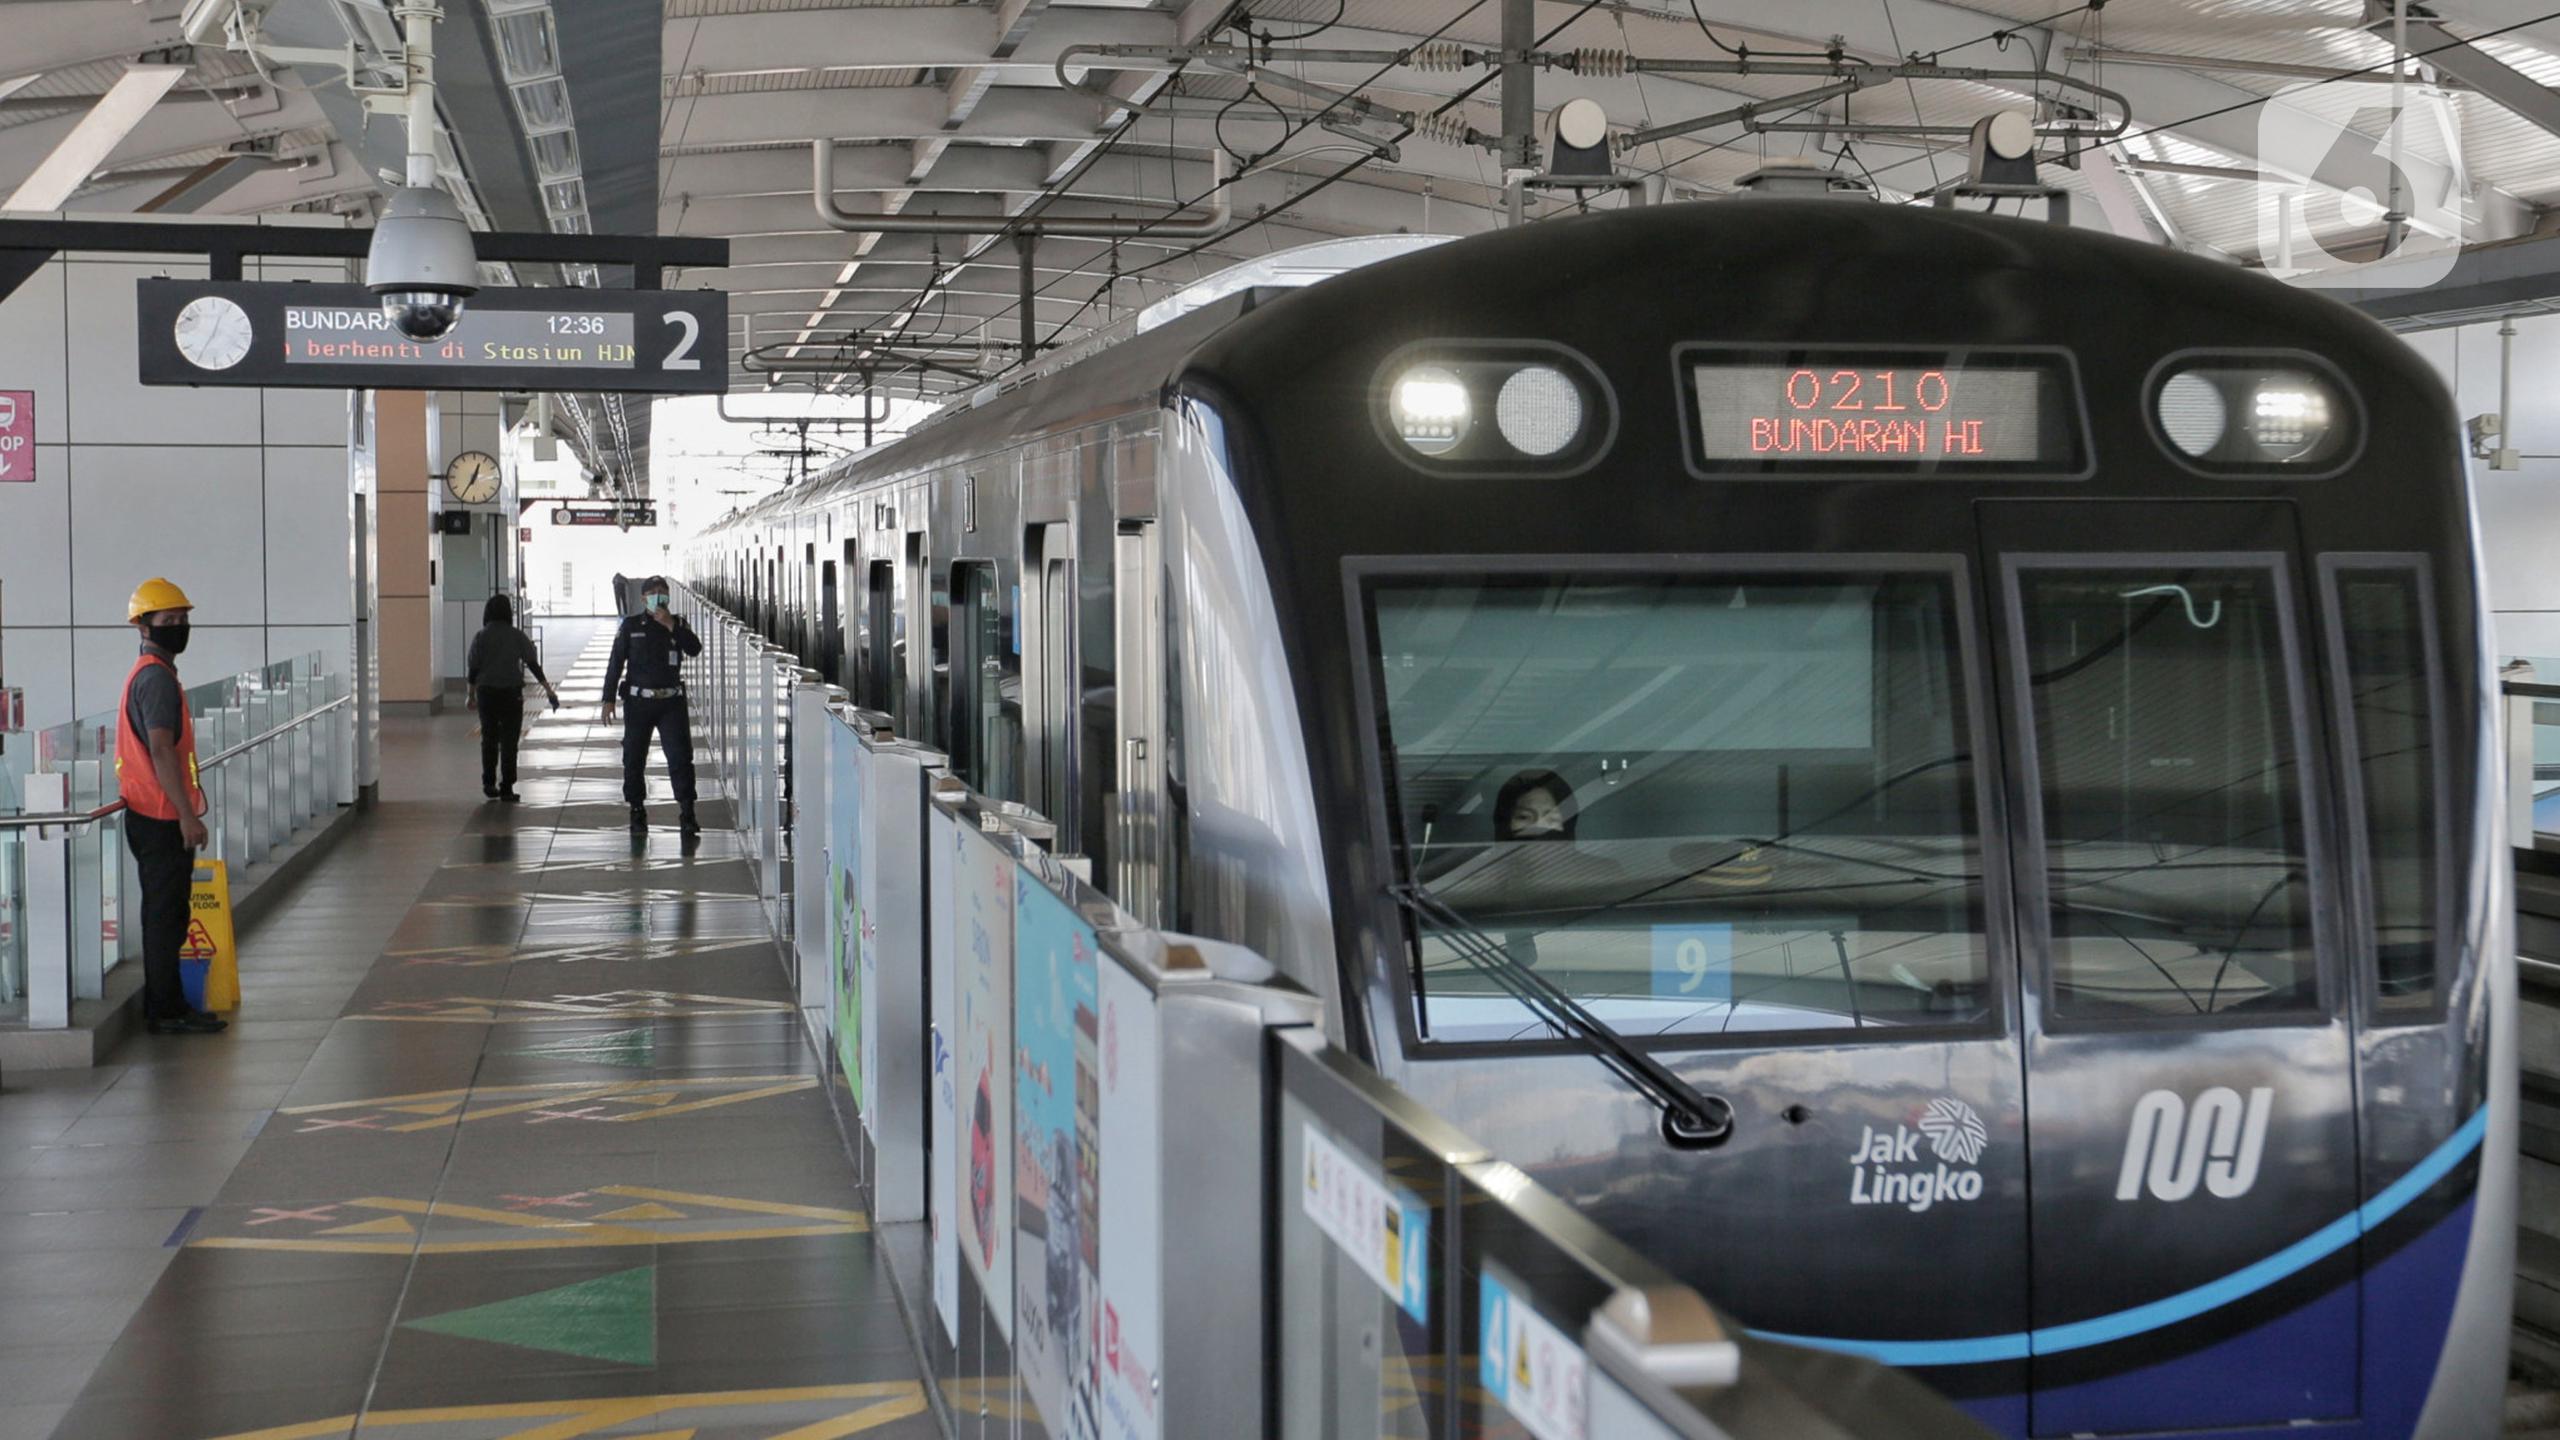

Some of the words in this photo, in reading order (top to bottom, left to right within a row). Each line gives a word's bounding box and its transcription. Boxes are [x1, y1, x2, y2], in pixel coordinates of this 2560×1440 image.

[547, 316, 605, 335] 12:36
[661, 310, 701, 371] 2
[307, 339, 423, 359] berhenti
[441, 342, 465, 359] di
[483, 342, 583, 361] Stasiun
[1786, 369, 1950, 412] 0210
[1751, 417, 1926, 453] BUNDARAN
[1945, 420, 1984, 454] HI
[192, 901, 220, 910] FLOOR
[1676, 938, 1707, 993] 9
[1850, 1125, 1919, 1165] Jak
[1849, 1162, 1983, 1213] Lingko
[1405, 1225, 1422, 1306] 4
[1488, 1295, 1507, 1391] 4
